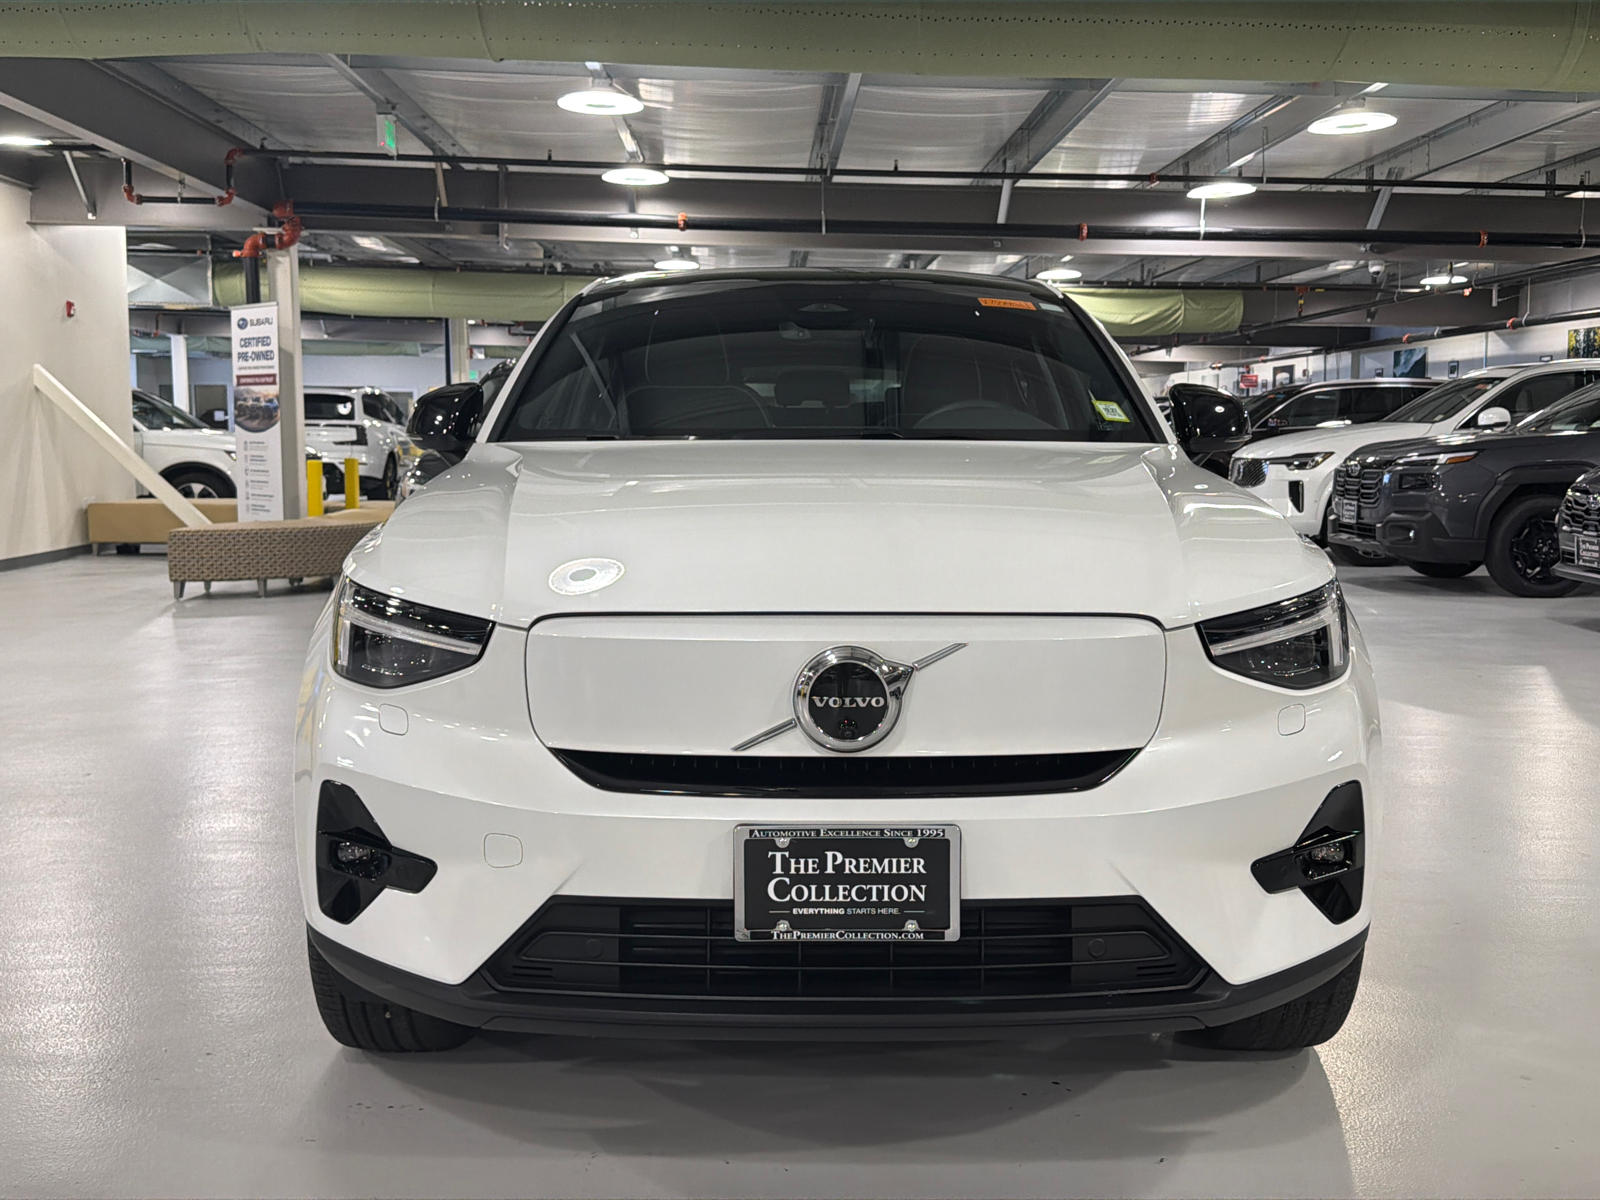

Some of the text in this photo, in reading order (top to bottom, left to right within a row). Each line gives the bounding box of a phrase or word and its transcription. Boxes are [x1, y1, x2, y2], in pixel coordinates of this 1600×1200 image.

[250, 317, 273, 327] SUBARU
[240, 335, 271, 348] CERTIFIED
[237, 350, 275, 362] PRE-OWNED
[811, 696, 885, 708] VOLVO
[751, 829, 944, 837] AUTOMOTIVE EXCELLENCE SINCE 1995
[767, 851, 927, 874] THE PREMIER
[767, 877, 927, 902] COLLECTION
[770, 931, 924, 940] THEPREMIERCOLLECTION.COM
